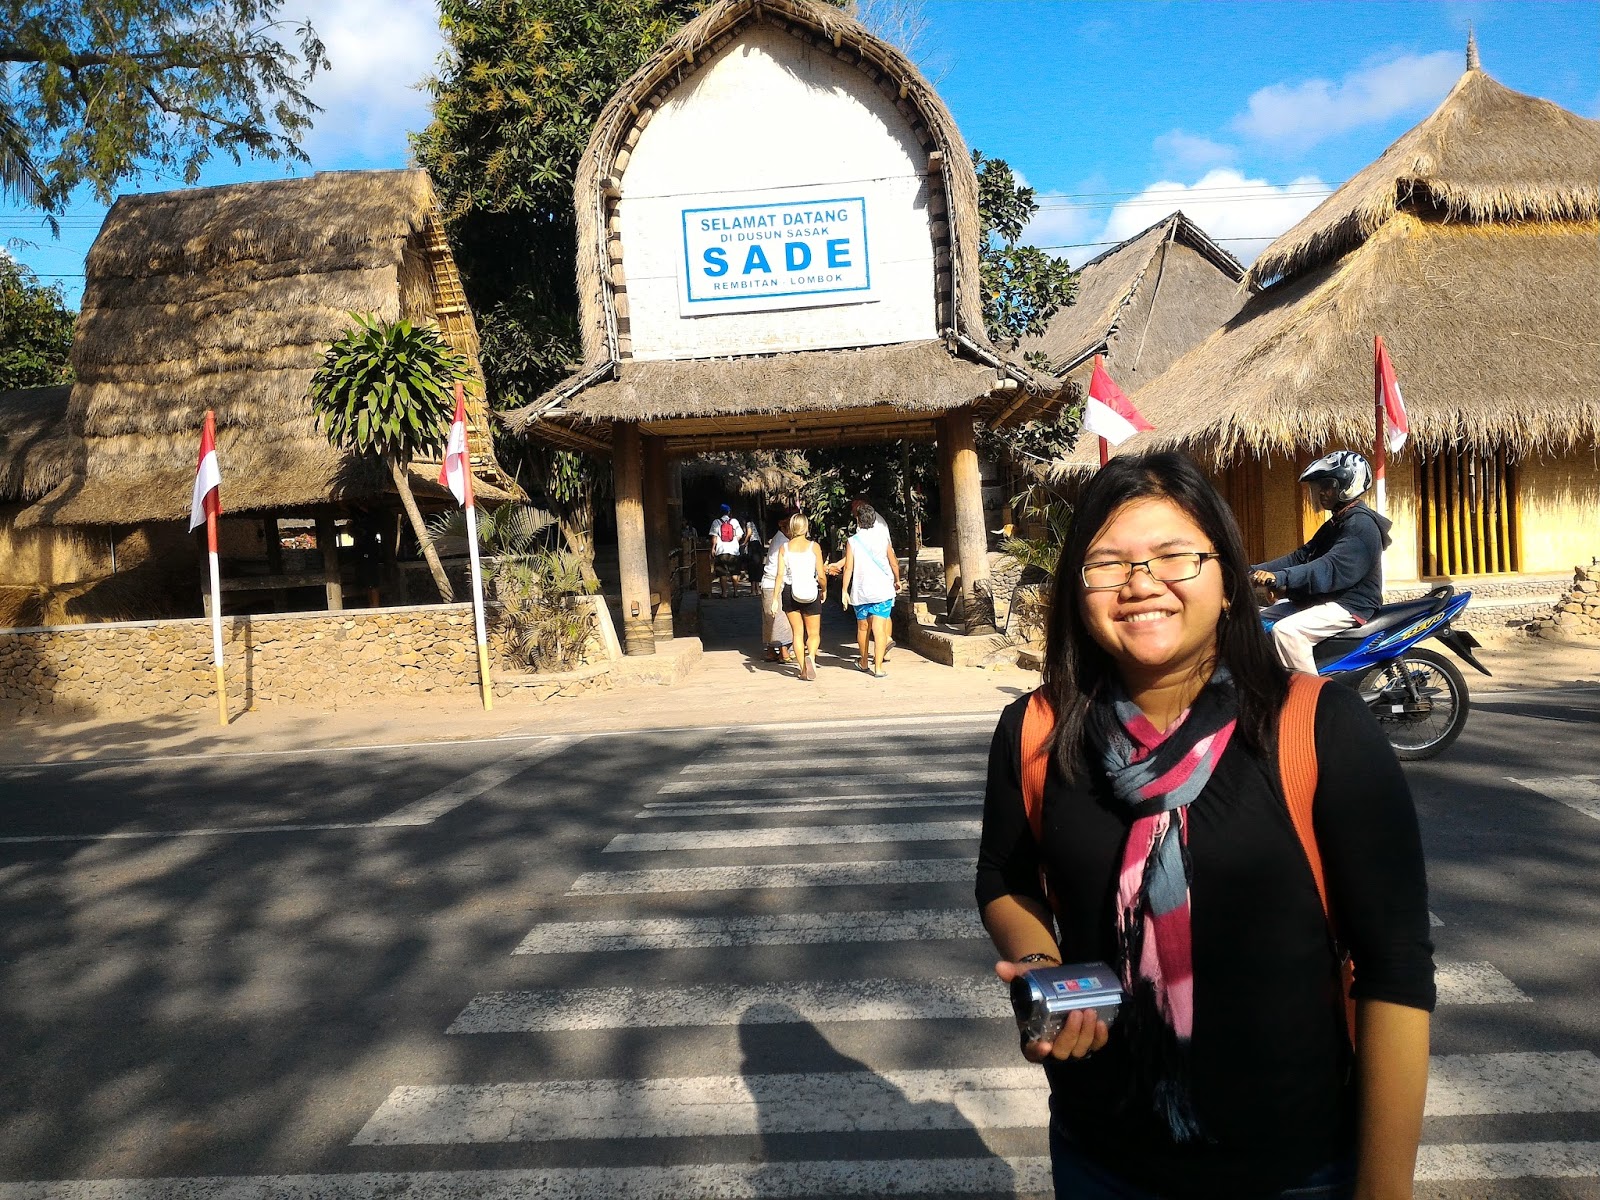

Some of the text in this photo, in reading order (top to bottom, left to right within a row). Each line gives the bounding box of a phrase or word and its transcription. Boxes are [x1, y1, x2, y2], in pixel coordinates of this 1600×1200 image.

[701, 209, 848, 231] SELAMAT DATANG
[720, 227, 829, 242] DI DUSUN SASAK
[703, 238, 852, 277] SADE
[713, 274, 843, 290] REMBITAN LOMBOK
